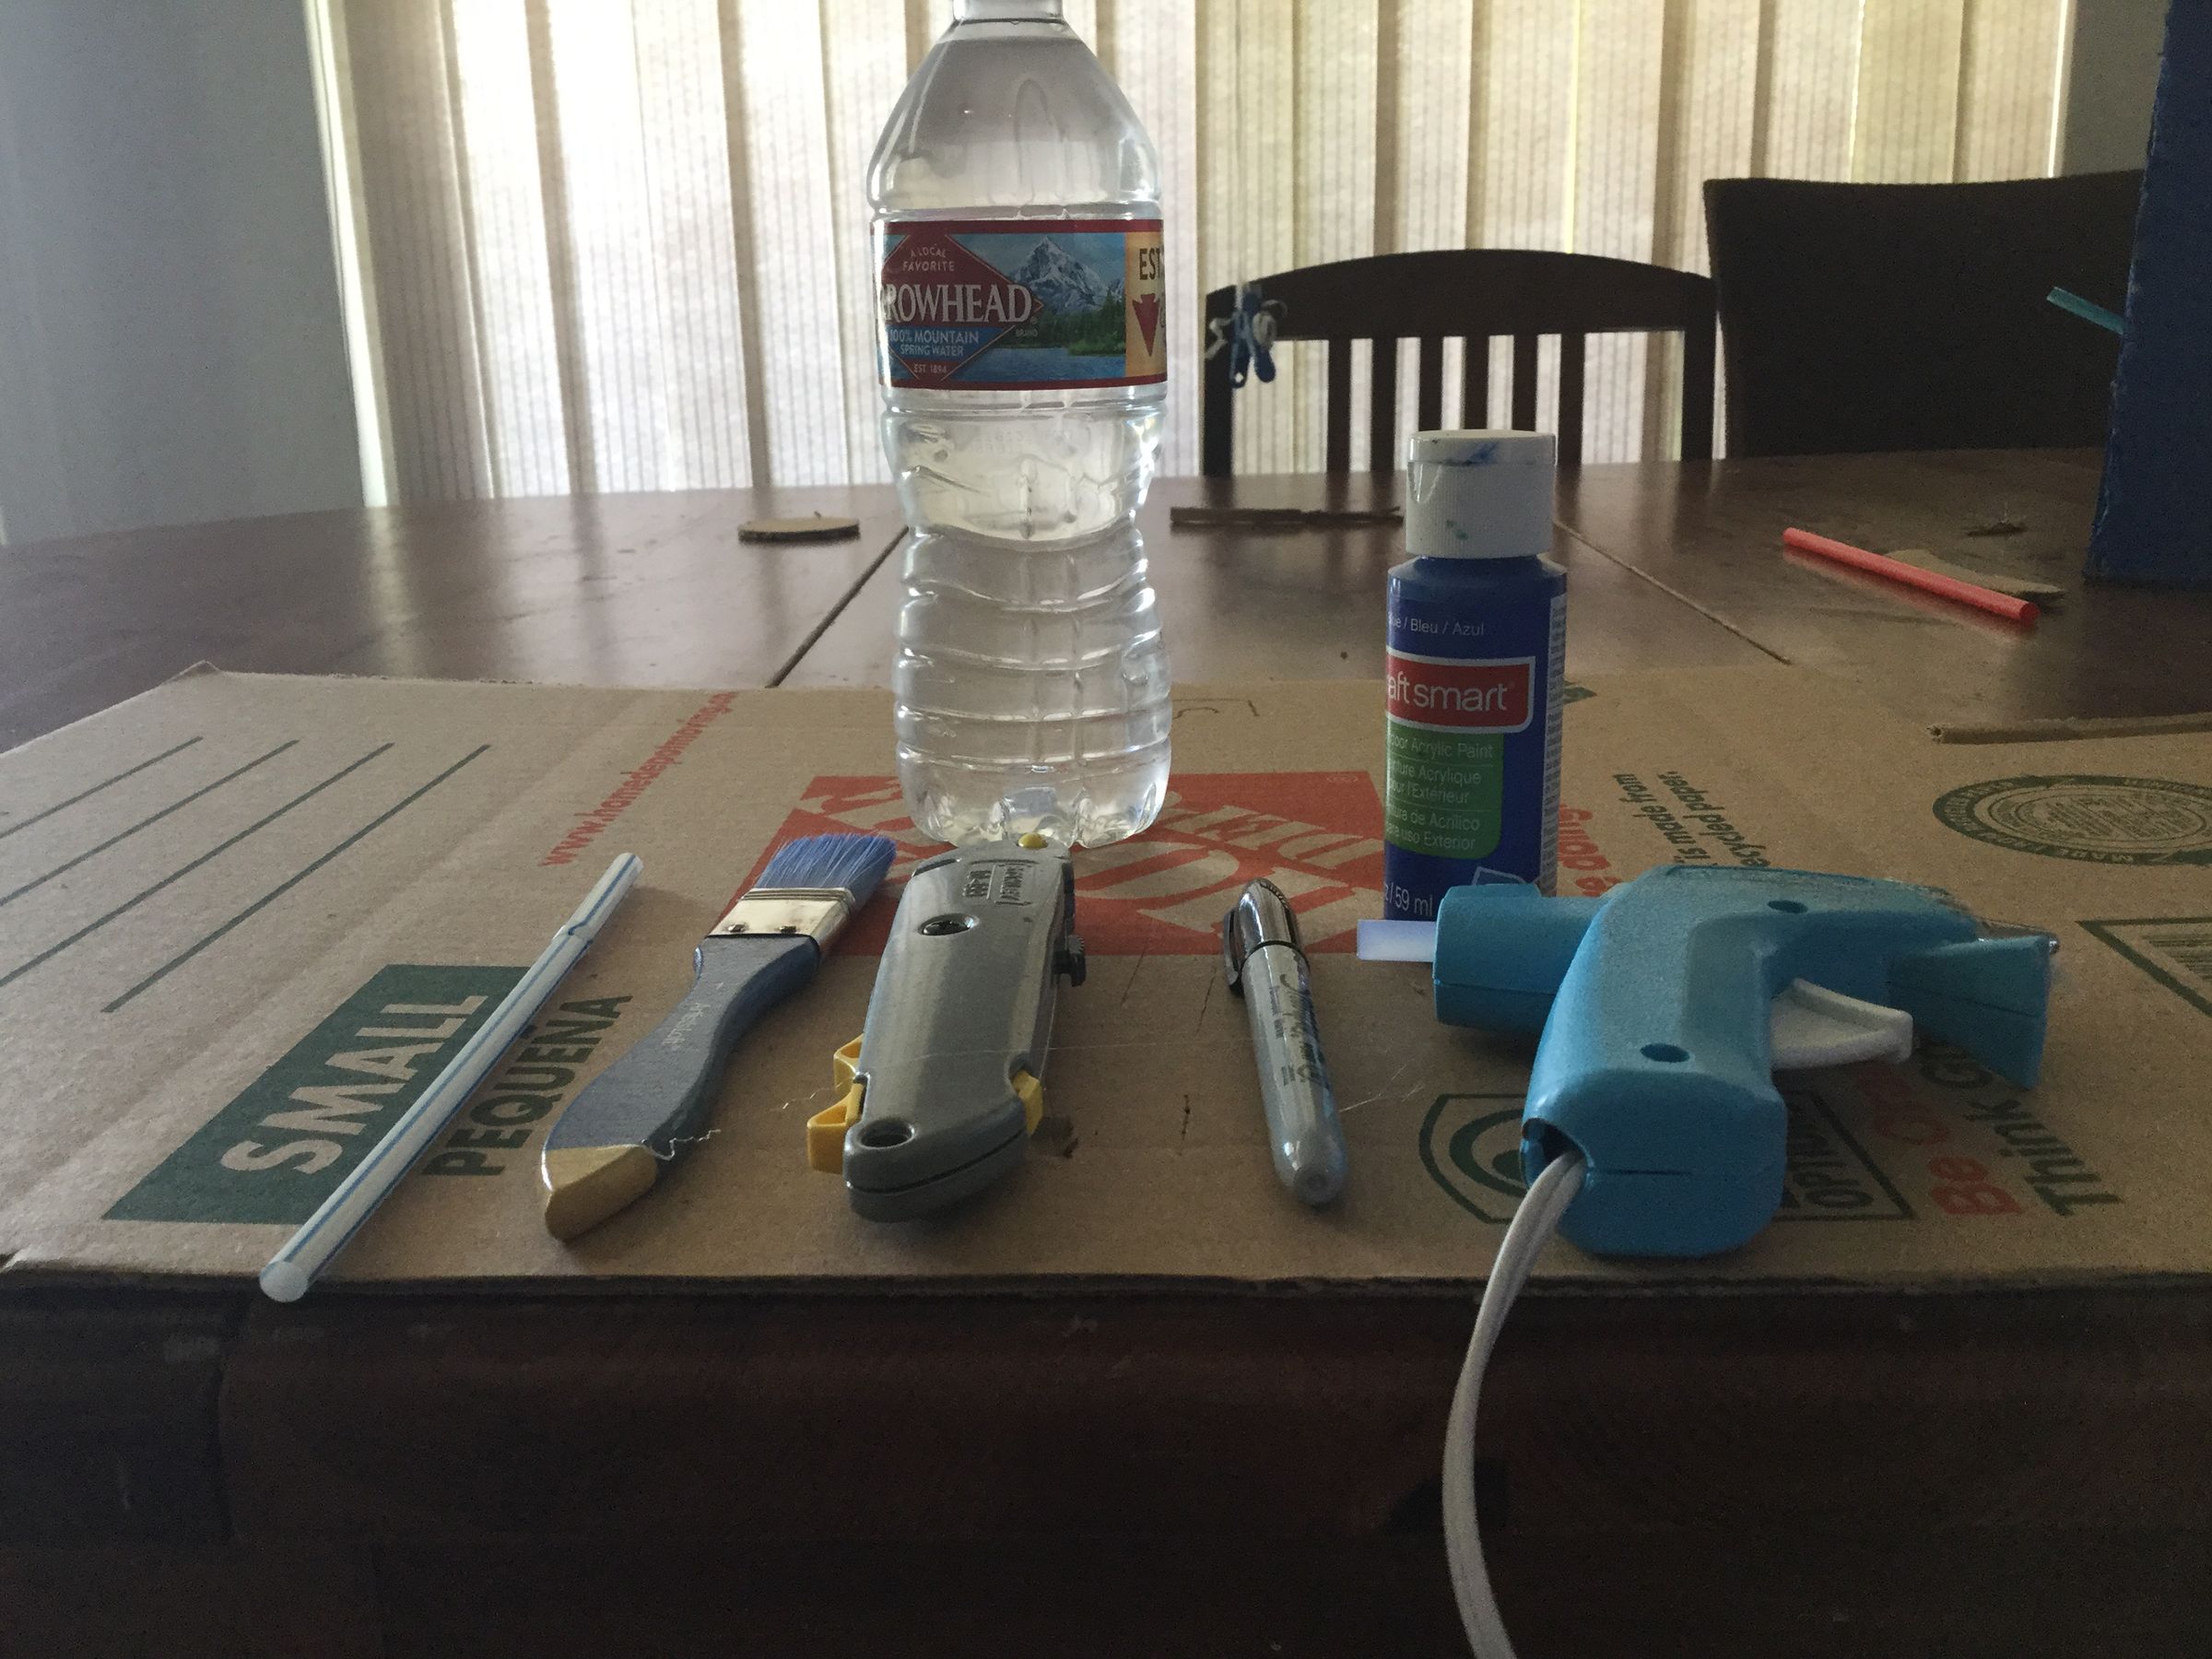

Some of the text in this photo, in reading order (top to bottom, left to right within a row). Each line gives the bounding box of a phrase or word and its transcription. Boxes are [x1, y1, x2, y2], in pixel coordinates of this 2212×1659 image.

[919, 246, 947, 258] LOCAL
[902, 261, 956, 273] FAVORITE
[881, 283, 1032, 324] ROWHEAD
[914, 330, 980, 345] MOUNTAIN
[900, 344, 965, 357] SPRING WATER
[1410, 618, 1439, 634] Bleu
[1452, 621, 1485, 636] Azul
[1411, 737, 1453, 759] Acrylic
[1457, 742, 1495, 759] Paint
[1418, 765, 1482, 789] Acrylique
[1613, 773, 1657, 803] from
[1632, 804, 1697, 845] made
[1424, 830, 1477, 851] Exterior
[1683, 813, 1771, 866] ecycled
[1414, 894, 1434, 917] ml
[220, 994, 489, 1175] SMALL
[1963, 1100, 2123, 1217] Think
